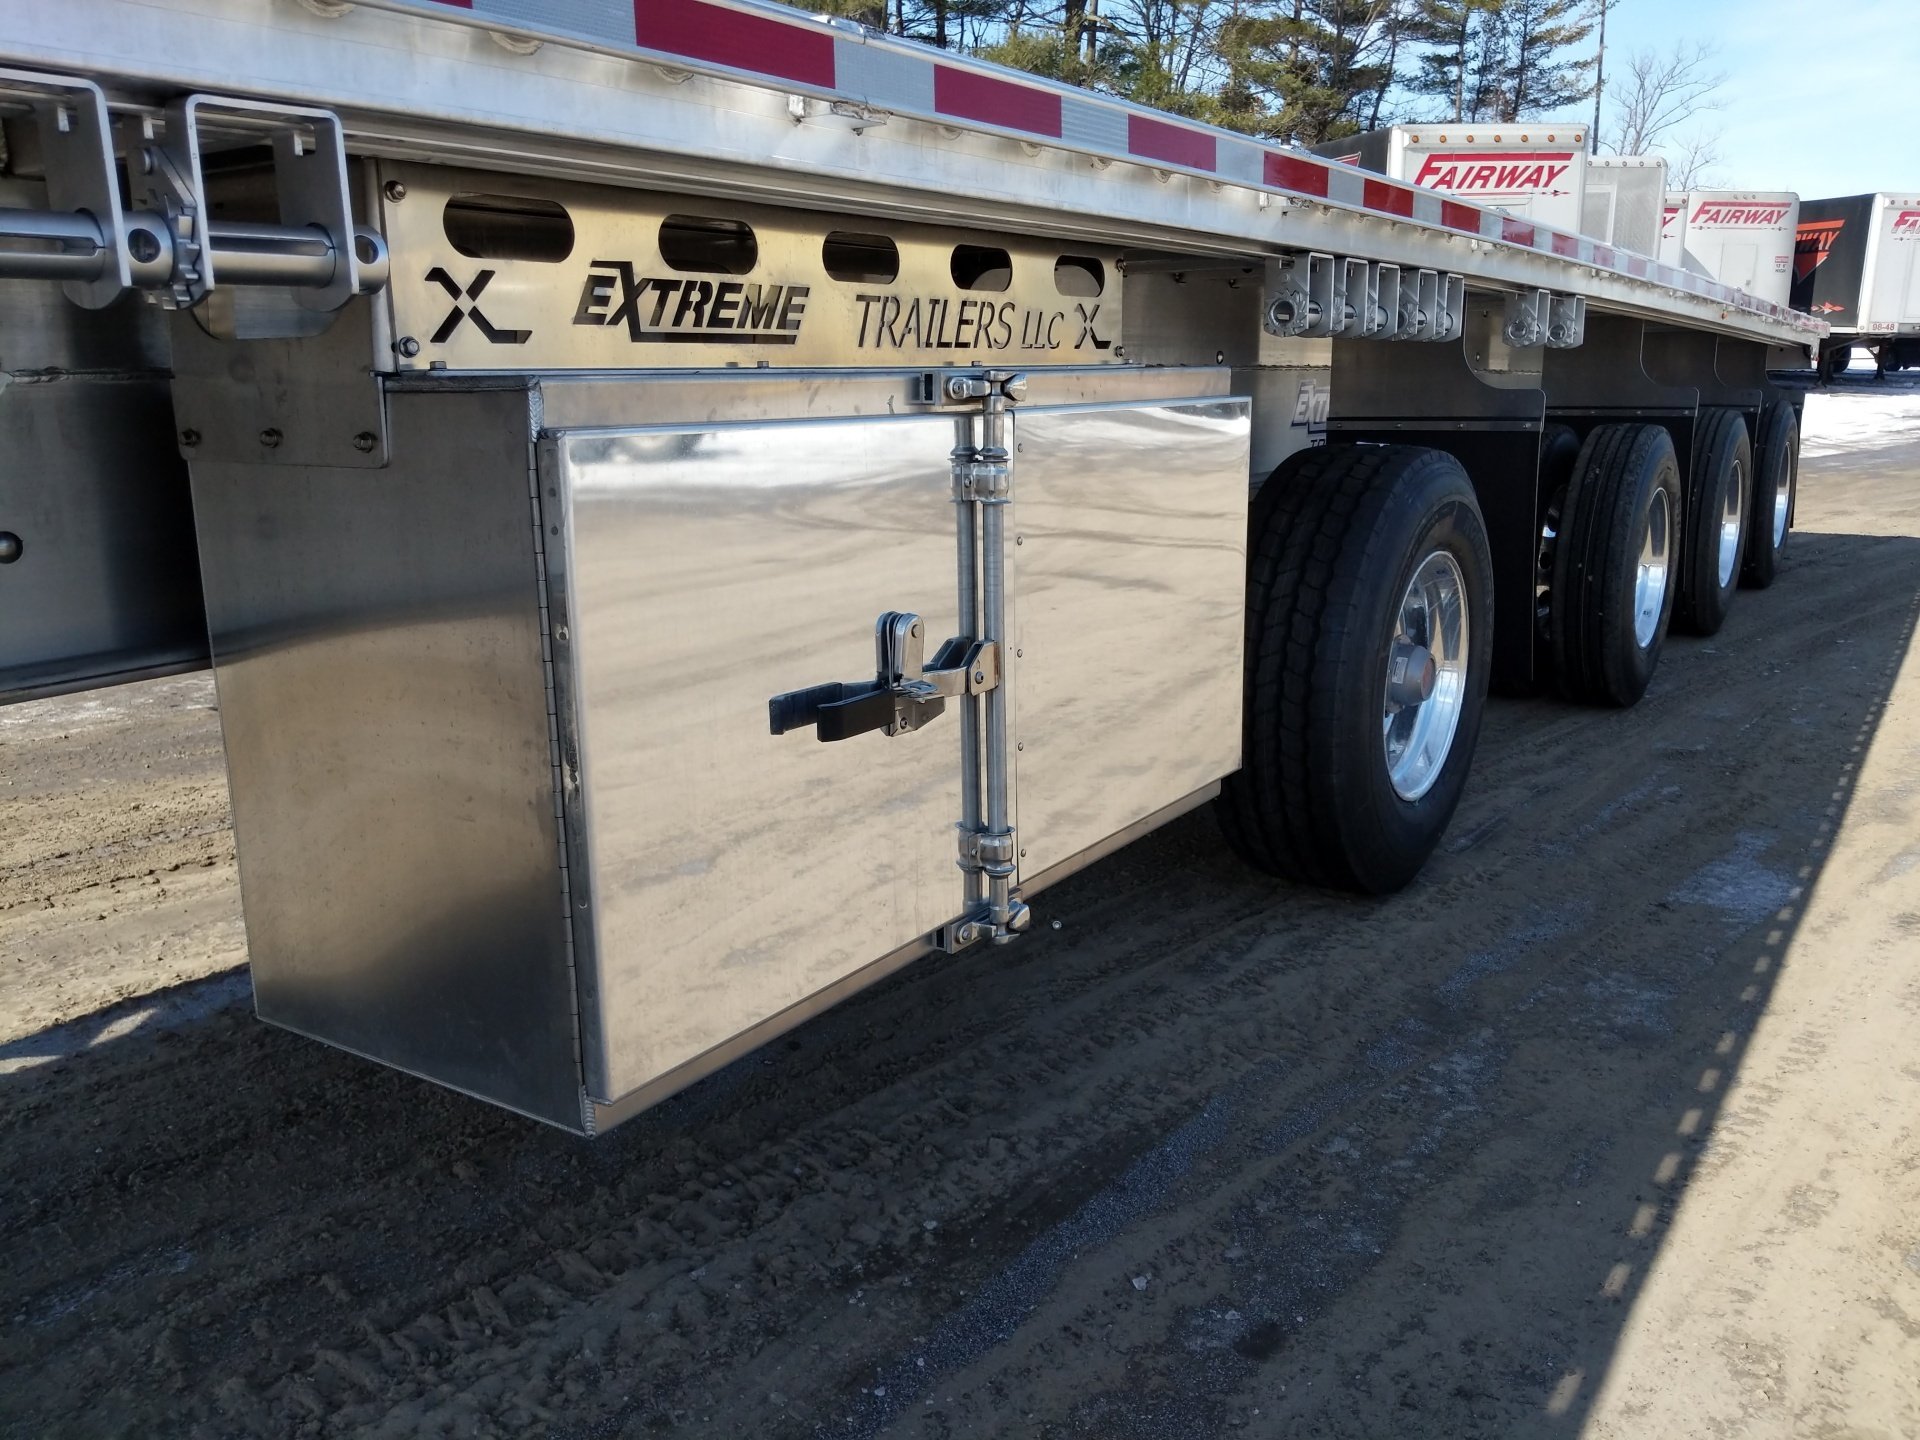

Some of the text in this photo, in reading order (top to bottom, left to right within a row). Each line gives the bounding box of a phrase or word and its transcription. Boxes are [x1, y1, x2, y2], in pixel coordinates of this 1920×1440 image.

[1413, 152, 1575, 190] FAIRWAY
[1690, 201, 1793, 225] FAIRWAY
[572, 260, 811, 345] EXTREME
[855, 294, 1016, 350] TRAILERS
[1020, 310, 1065, 350] LLC
